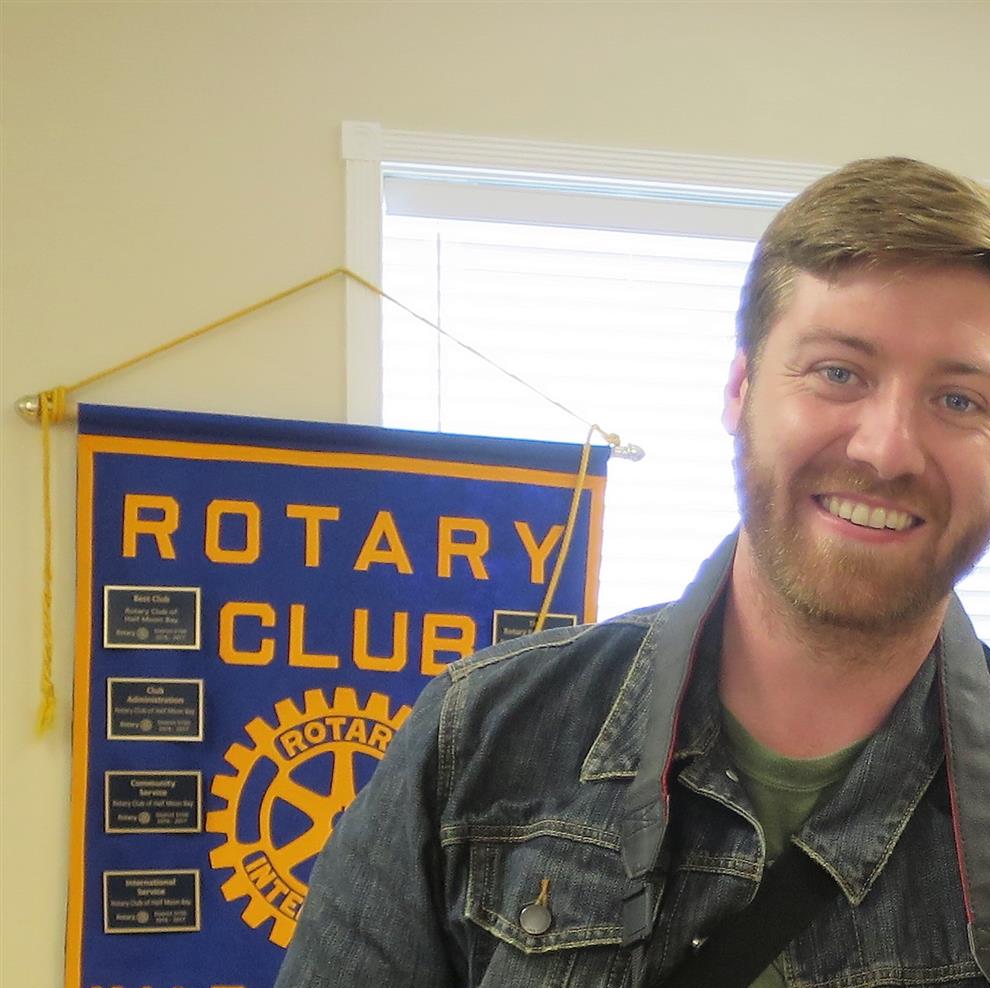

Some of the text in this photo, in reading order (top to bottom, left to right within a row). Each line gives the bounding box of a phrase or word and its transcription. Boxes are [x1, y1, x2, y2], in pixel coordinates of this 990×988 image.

[121, 494, 566, 584] ROTARY
[218, 601, 478, 676] CLUB
[279, 716, 394, 758] ROTAR
